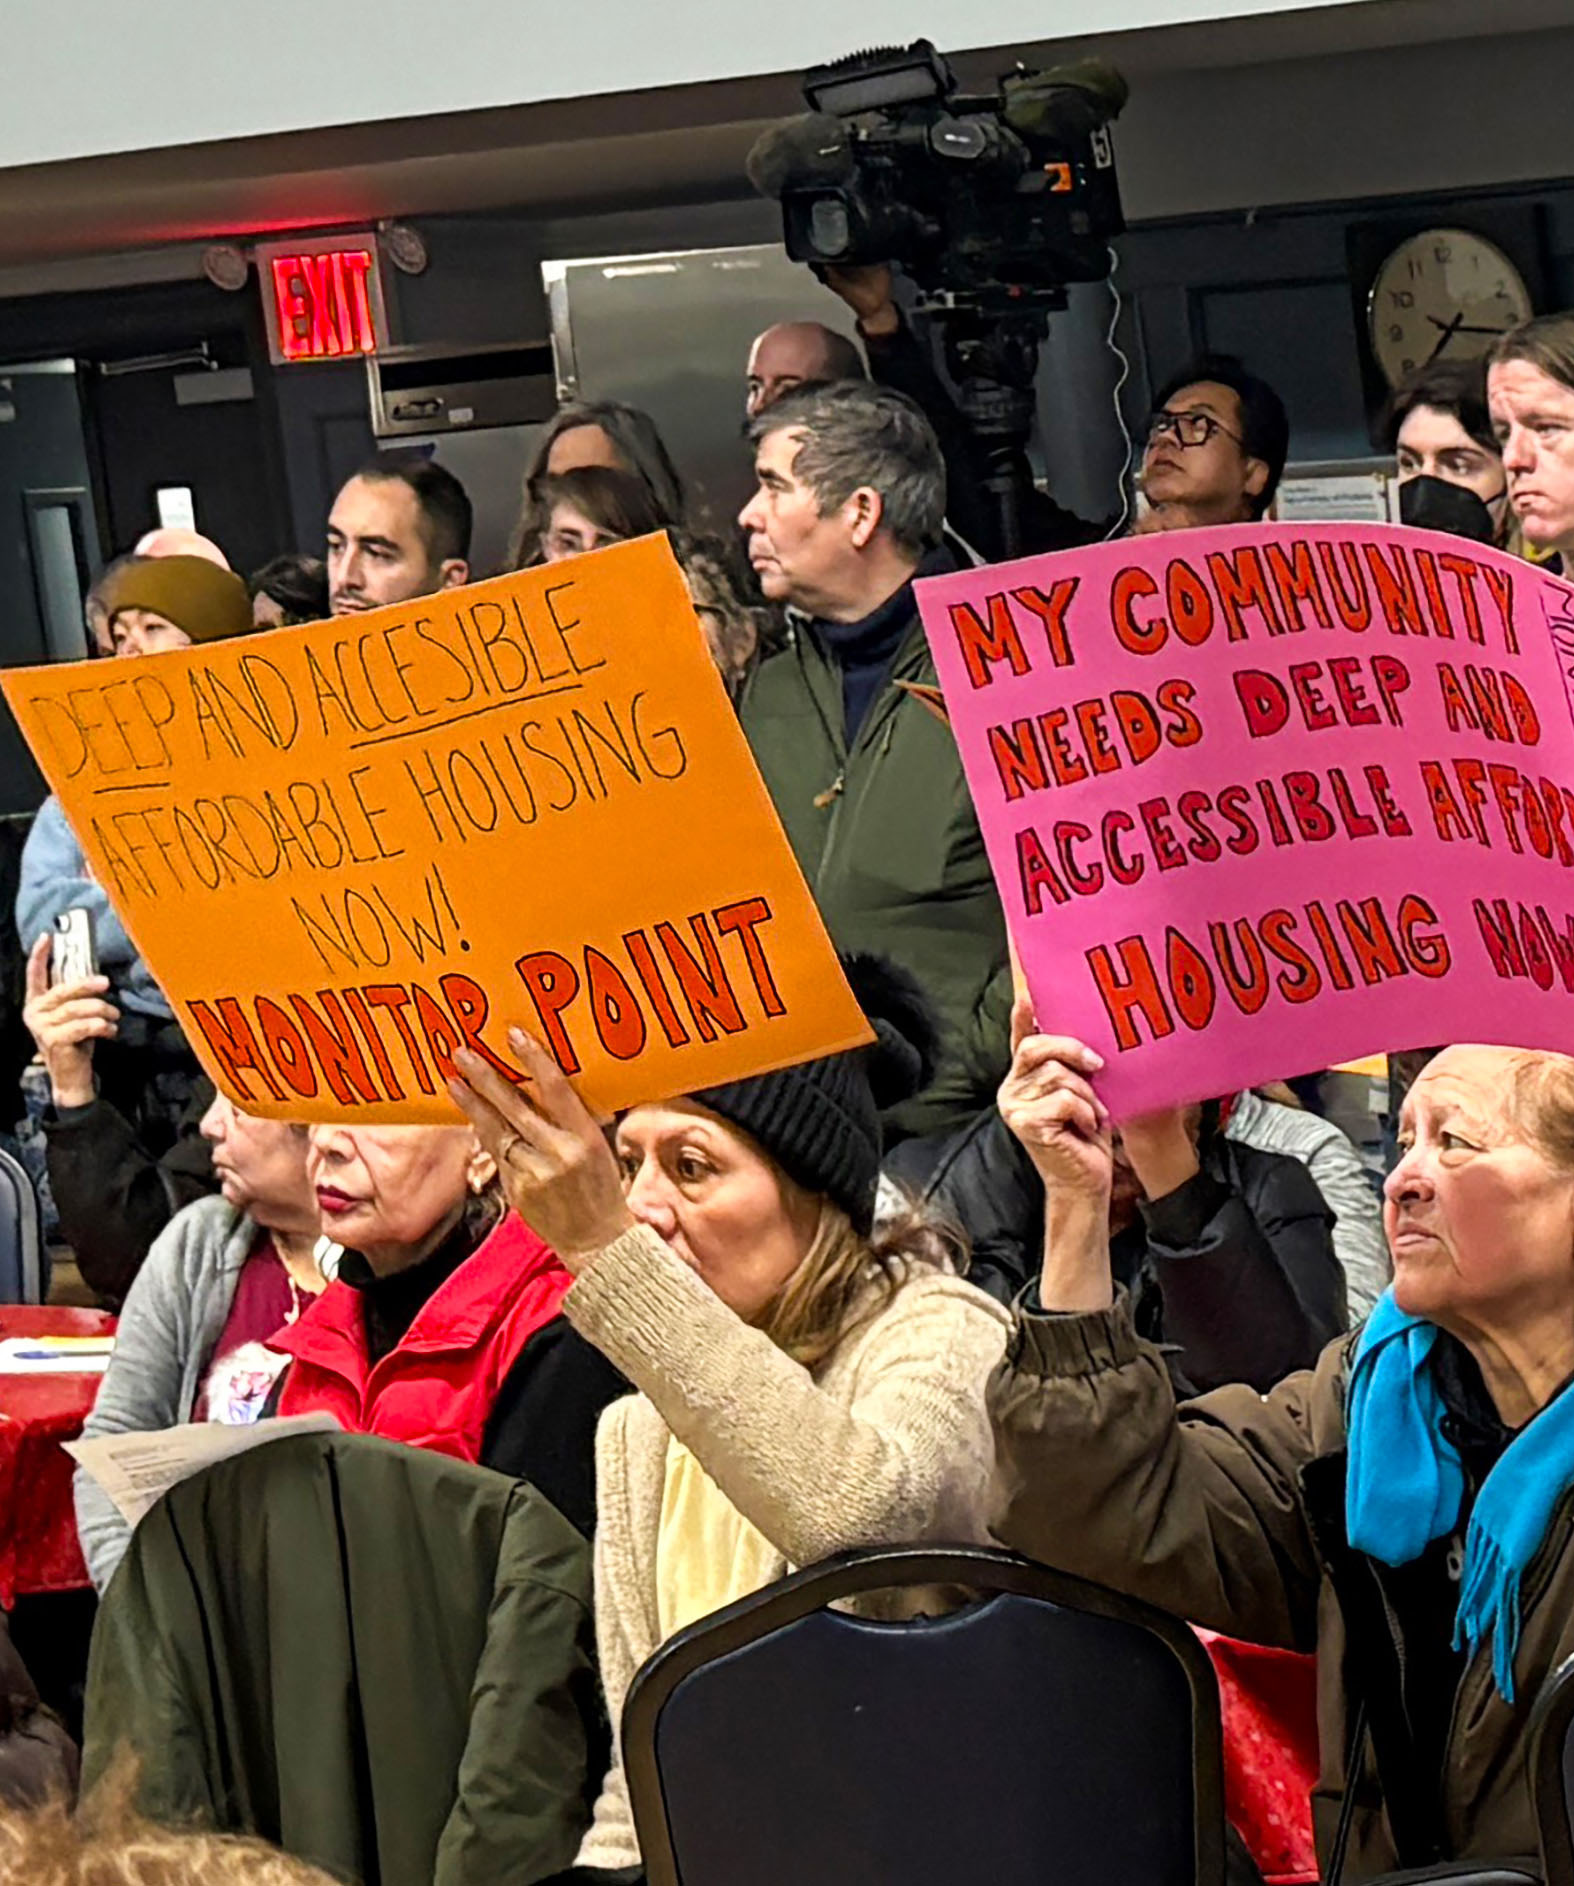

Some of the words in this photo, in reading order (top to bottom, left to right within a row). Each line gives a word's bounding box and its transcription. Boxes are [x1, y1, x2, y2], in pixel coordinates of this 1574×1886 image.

[272, 250, 376, 360] EXIT
[1387, 290, 1415, 309] 10
[1407, 257, 1424, 281] 11
[1434, 246, 1452, 264] 12
[1495, 279, 1510, 299] 2
[1390, 324, 1403, 342] 9
[30, 674, 175, 780] DEEP
[195, 653, 296, 759] AND
[315, 579, 607, 738] ACCESIBLE
[947, 575, 1082, 690] MY
[1109, 540, 1522, 657] COMMUNITY
[987, 678, 1204, 803] NEEDS
[1232, 653, 1413, 739] DEEP
[1436, 661, 1540, 747] AND
[91, 766, 406, 902] AFFORDABLE
[402, 690, 687, 845] HOUSING
[1014, 764, 1413, 917] ACCESSIBLE
[290, 863, 471, 976] NOW!
[1083, 892, 1452, 1053] HOUSING
[190, 971, 531, 1105] MONITOR
[517, 896, 787, 1076] POINT
